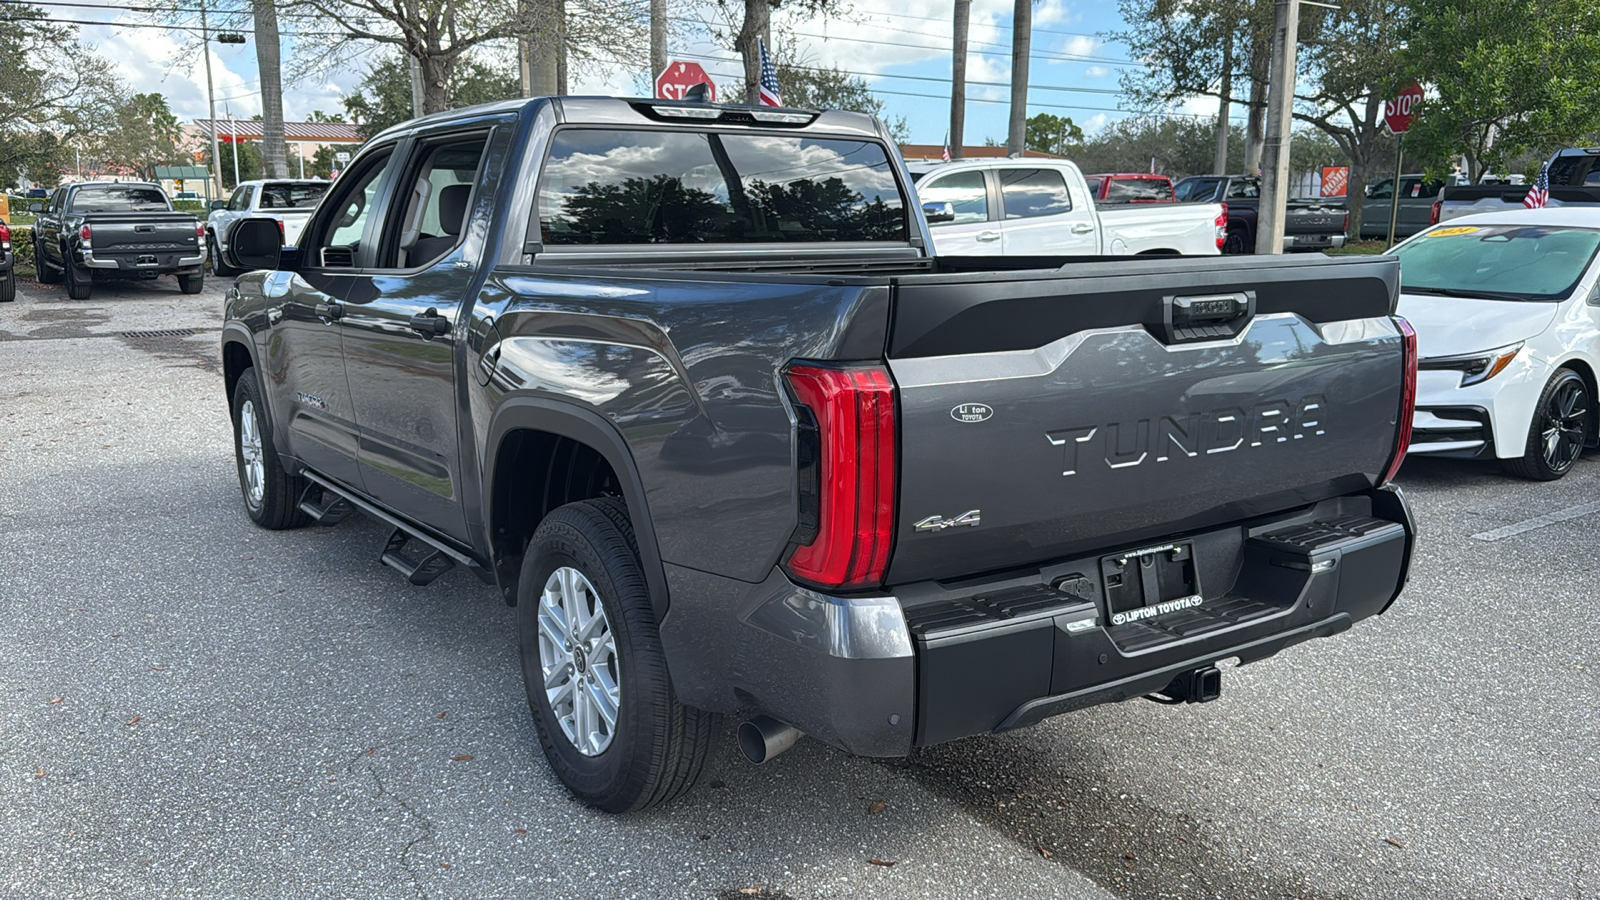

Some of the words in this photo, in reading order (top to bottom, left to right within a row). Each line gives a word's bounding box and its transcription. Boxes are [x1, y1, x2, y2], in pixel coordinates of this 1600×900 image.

[662, 83, 713, 101] ST
[1322, 166, 1348, 196] HOME
[1194, 302, 1230, 314] TOYOTA
[1045, 393, 1328, 476] TUNDRA
[1124, 544, 1174, 559] www.liptontoyota.com
[1125, 606, 1158, 623] LIPTON
[1157, 598, 1192, 615] TOYOTA
